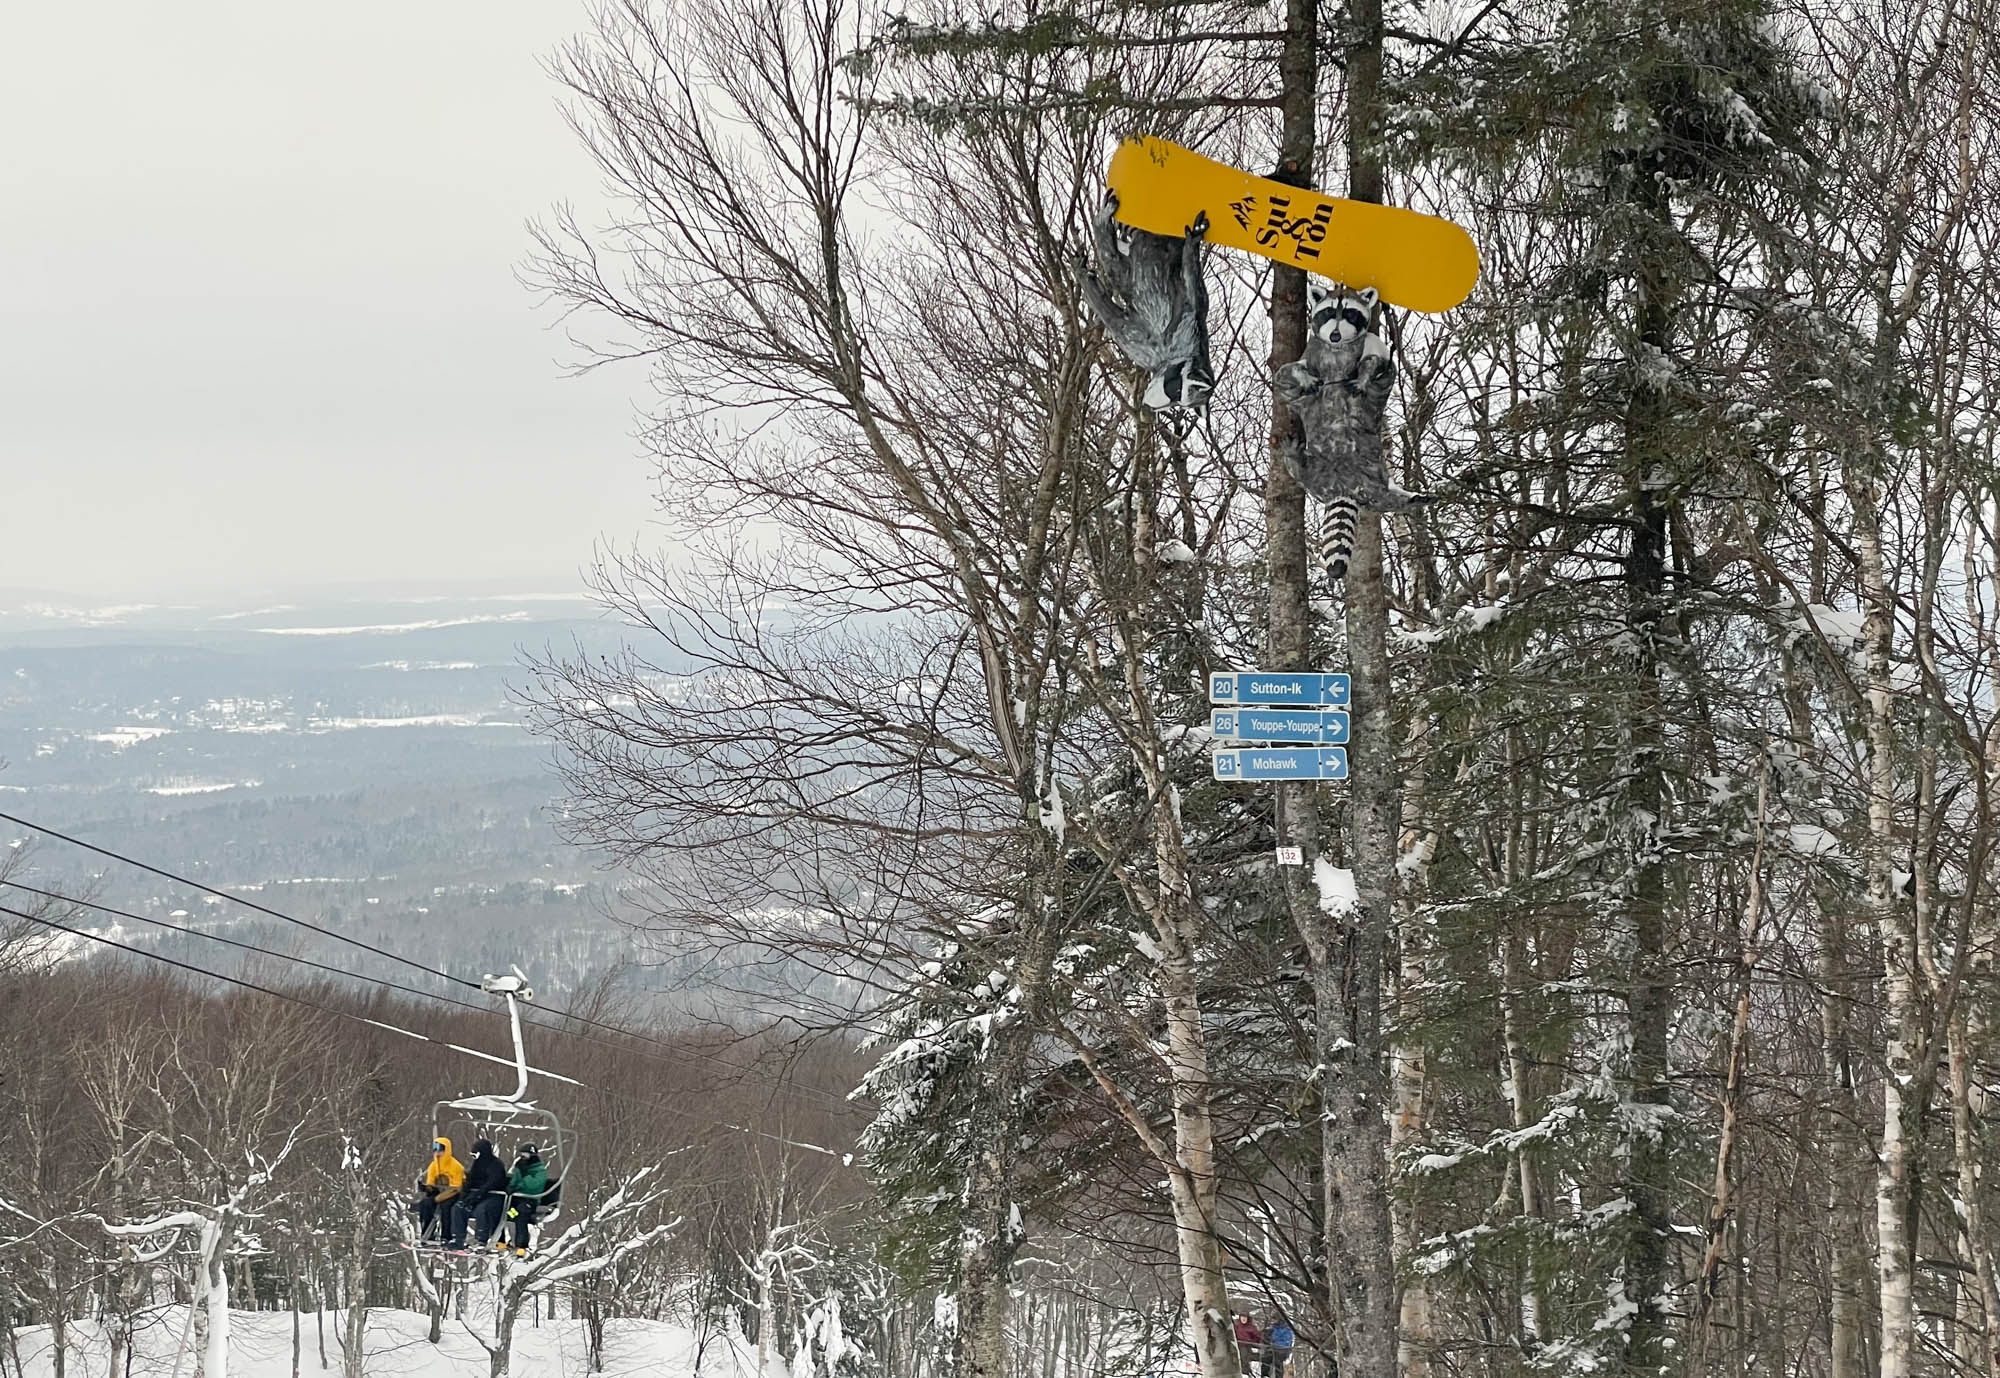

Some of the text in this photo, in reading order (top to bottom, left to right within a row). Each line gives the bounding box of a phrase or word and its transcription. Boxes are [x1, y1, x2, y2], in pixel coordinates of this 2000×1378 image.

[1256, 193, 1290, 248] Sut
[1280, 216, 1314, 240] &
[1294, 203, 1334, 261] Ton
[1215, 681, 1231, 694] 20
[1216, 717, 1320, 733] 26 Youppe-Youppe
[1219, 758, 1297, 771] 21 Mohawk
[1281, 852, 1296, 860] 132
